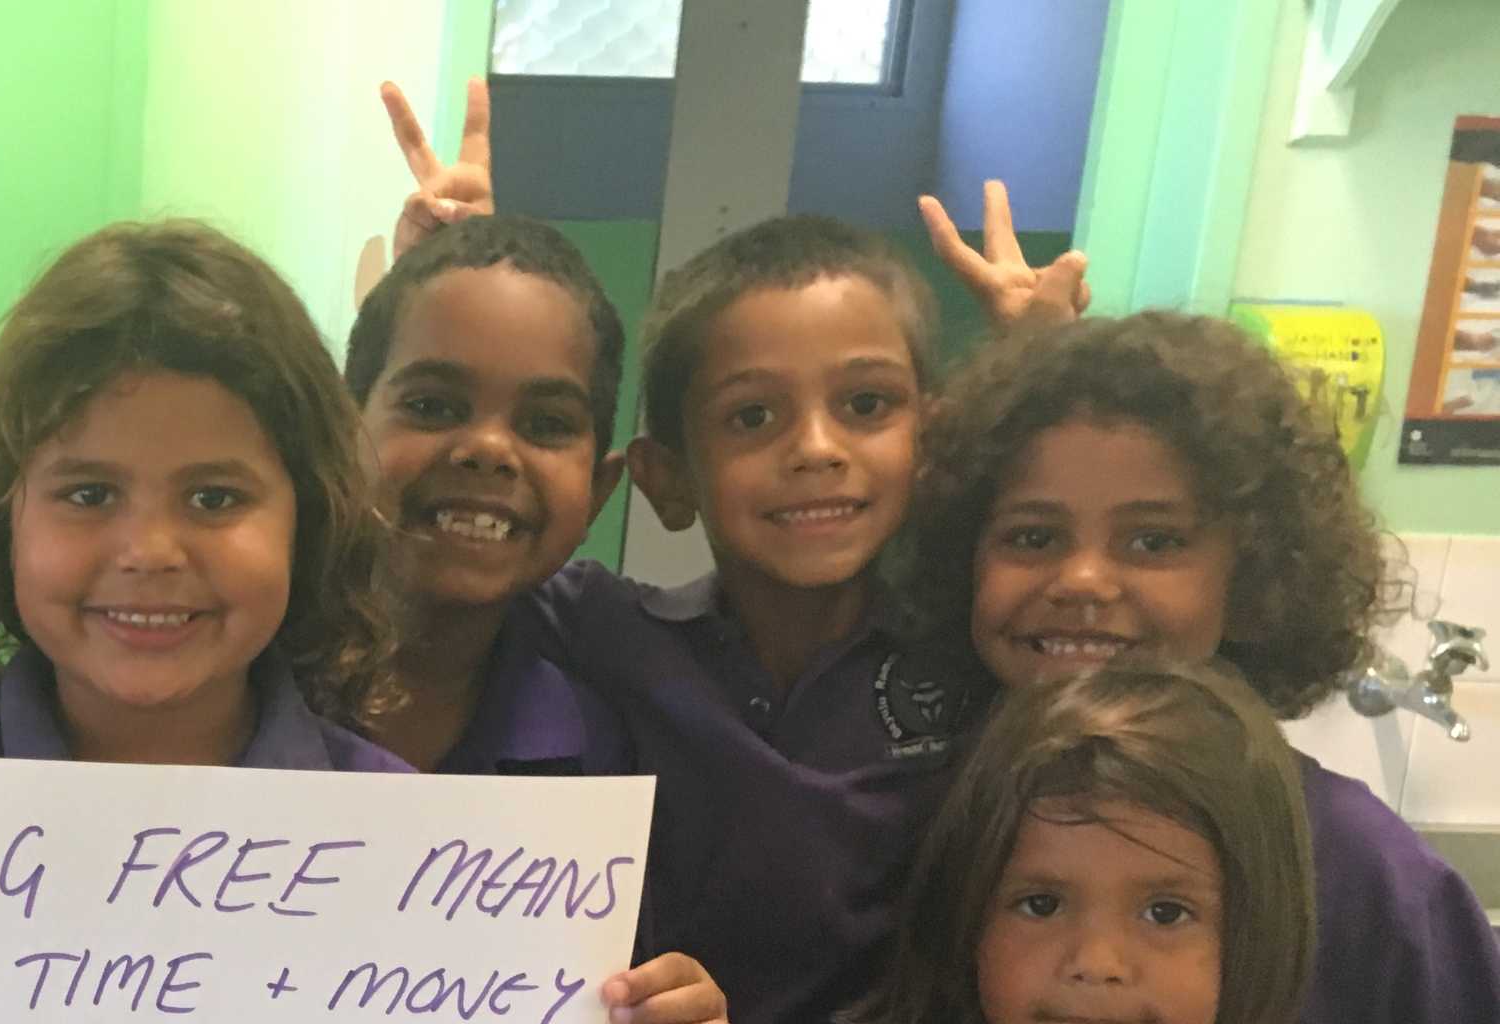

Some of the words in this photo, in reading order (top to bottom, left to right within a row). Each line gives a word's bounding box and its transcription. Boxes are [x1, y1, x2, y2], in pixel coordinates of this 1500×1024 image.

[106, 828, 366, 916] FREE
[397, 839, 635, 920] MEANS
[15, 949, 213, 1013] TIME
